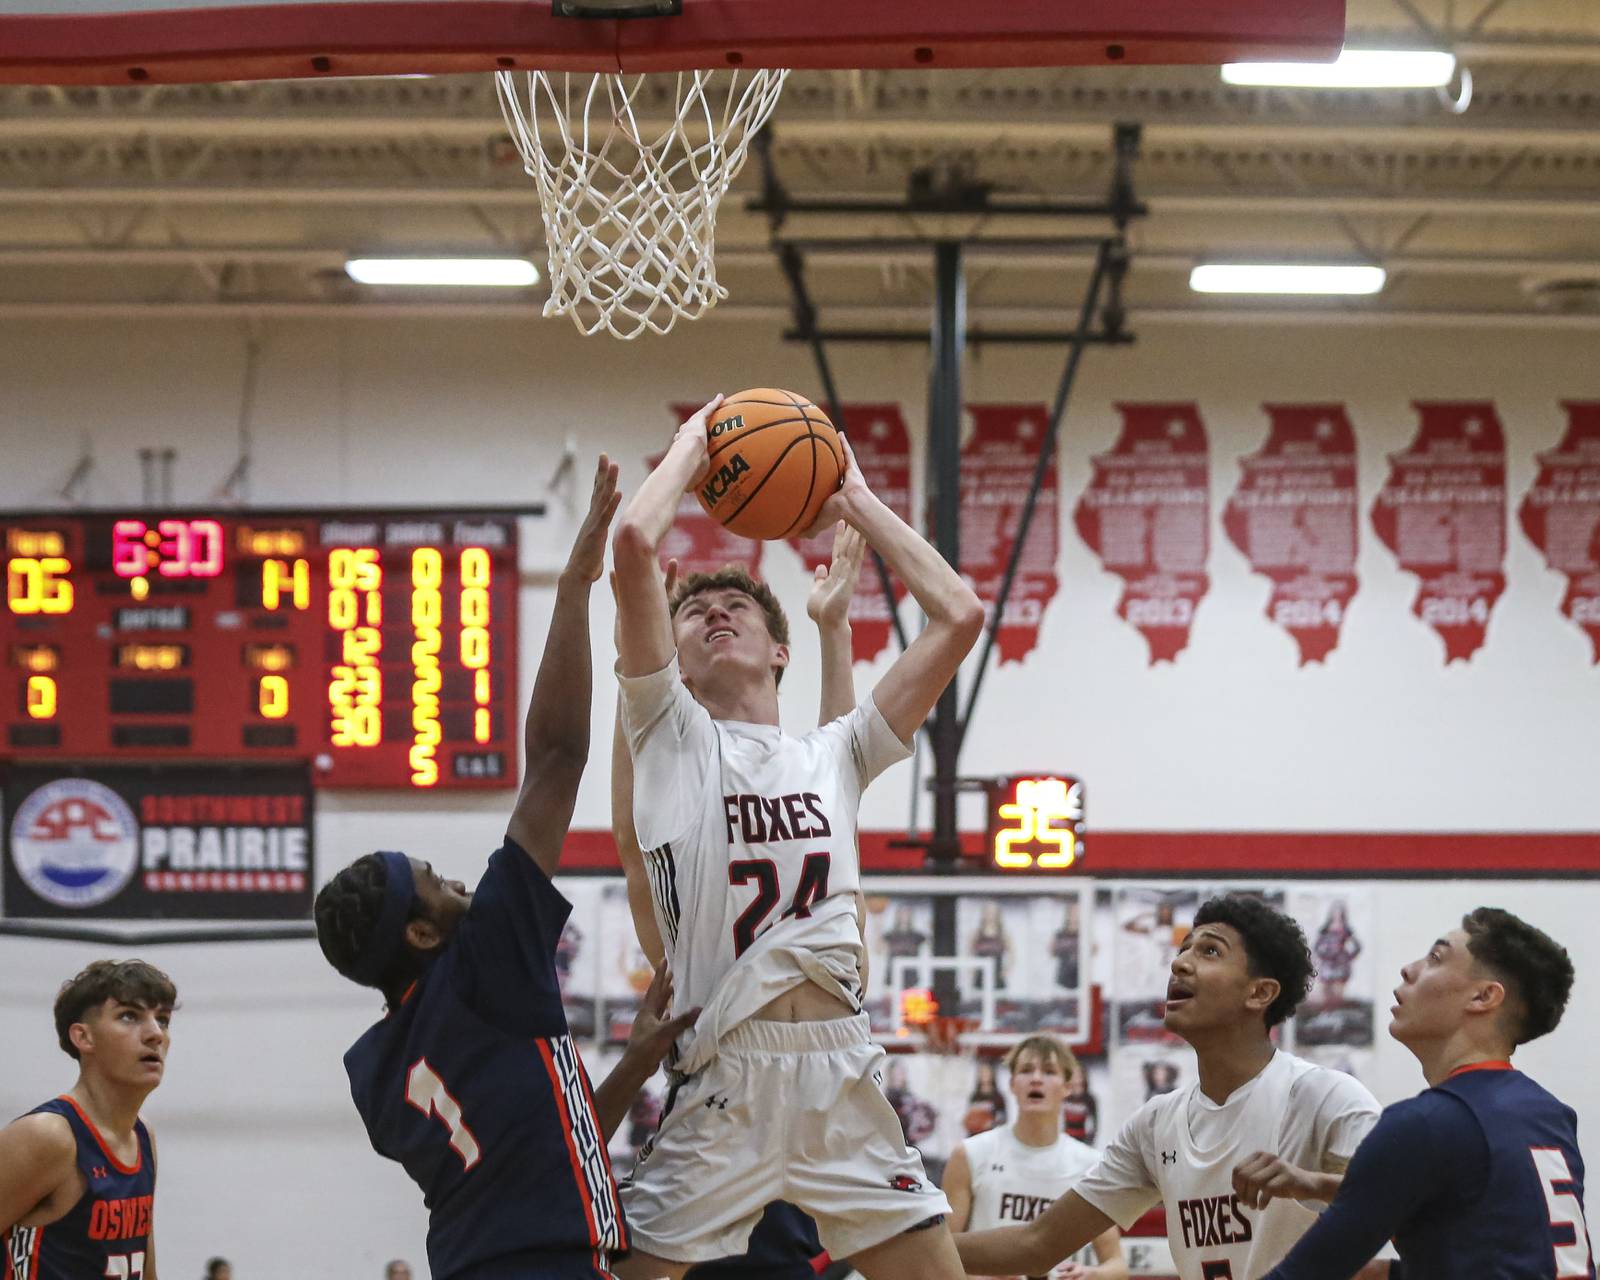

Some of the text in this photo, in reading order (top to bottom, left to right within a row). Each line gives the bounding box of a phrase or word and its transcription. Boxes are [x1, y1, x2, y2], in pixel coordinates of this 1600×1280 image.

[702, 453, 750, 509] NCAA
[113, 519, 223, 577] 6:30
[262, 558, 309, 611] 14
[27, 675, 57, 718] 0
[259, 675, 289, 718] 0
[723, 792, 832, 844] FOXES
[995, 803, 1075, 868] 25
[142, 827, 308, 870] PRAIRIE
[728, 851, 831, 961] 24
[88, 1195, 153, 1240] OSWE
[1000, 1193, 1054, 1222] FOXE
[1178, 1194, 1253, 1249] FOXES
